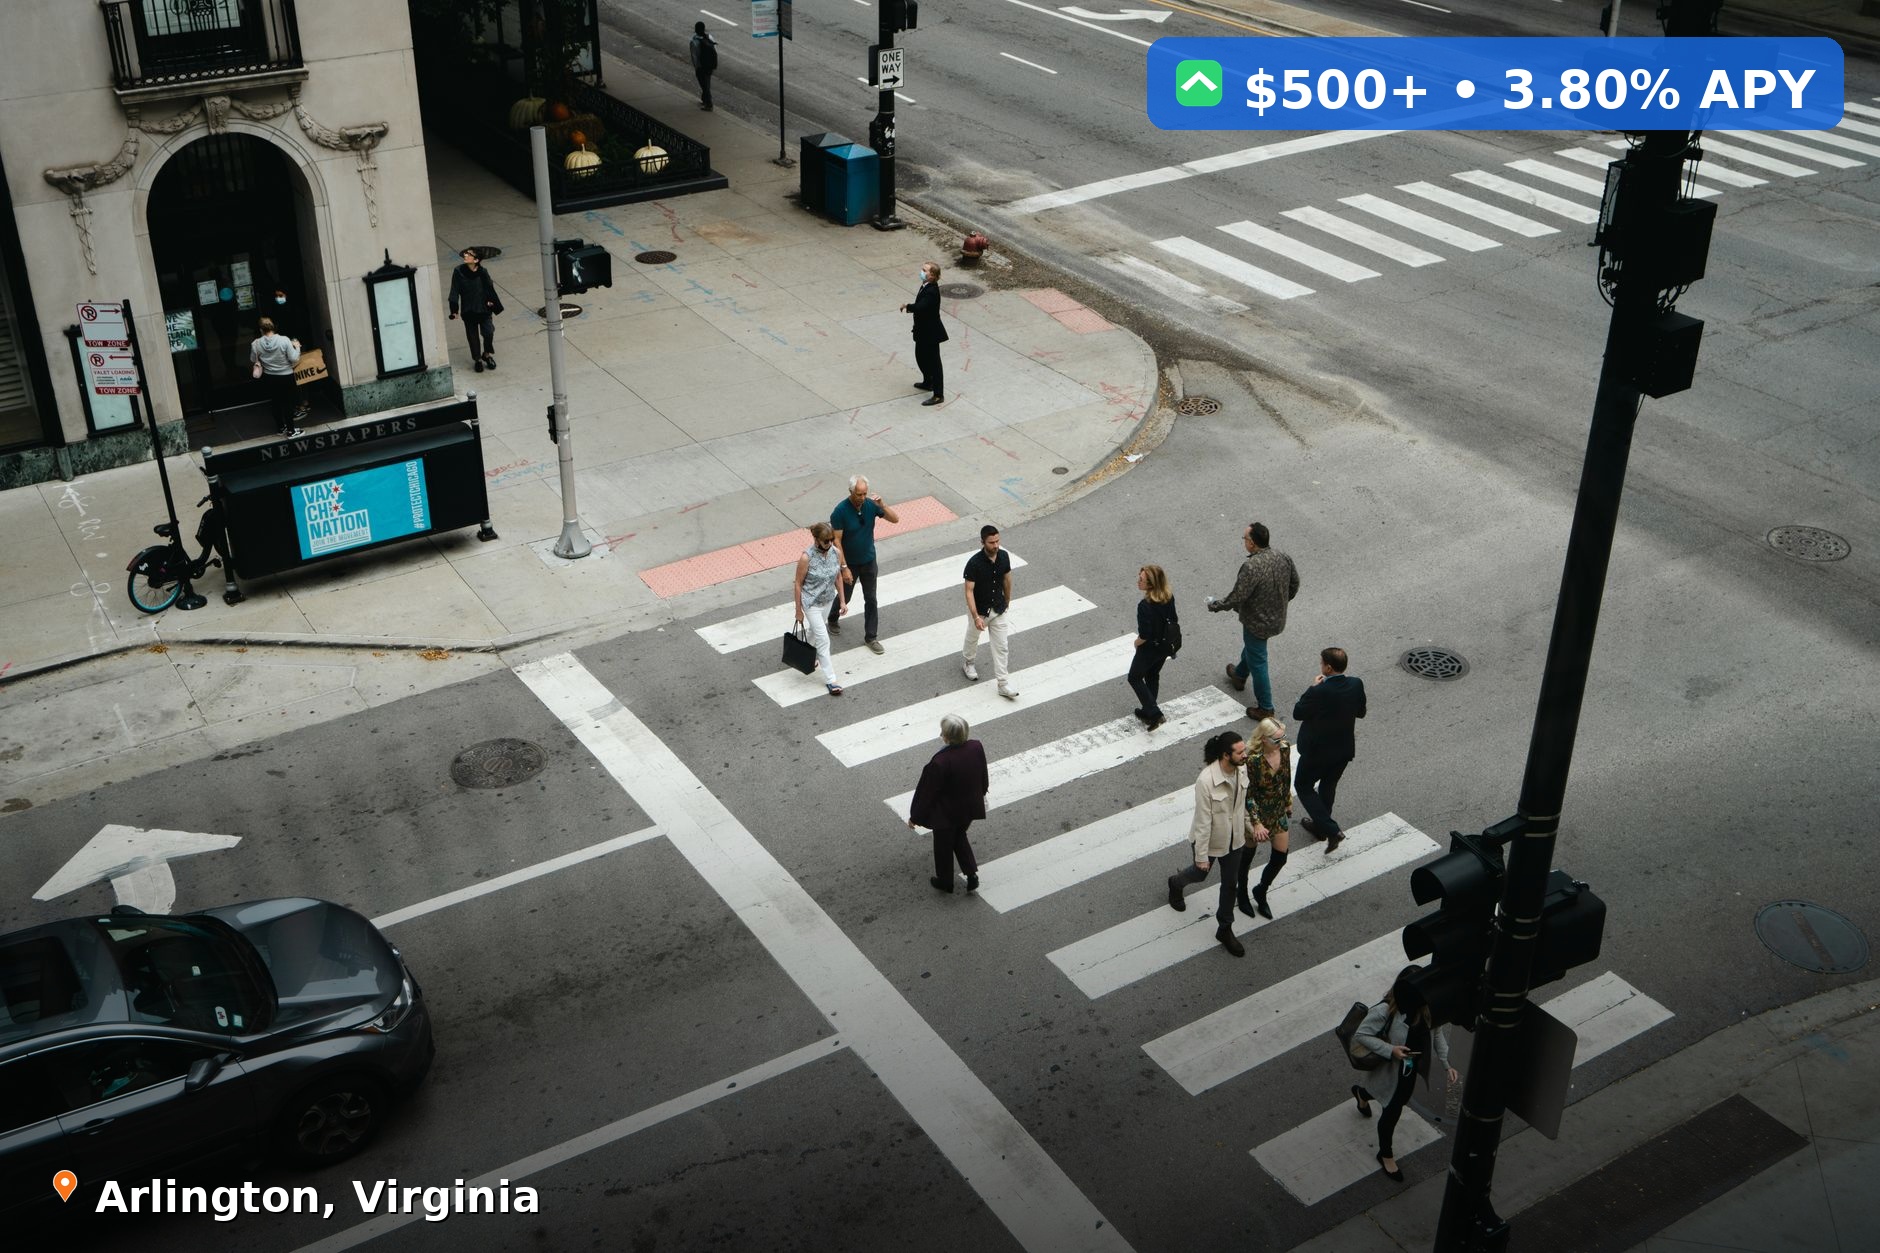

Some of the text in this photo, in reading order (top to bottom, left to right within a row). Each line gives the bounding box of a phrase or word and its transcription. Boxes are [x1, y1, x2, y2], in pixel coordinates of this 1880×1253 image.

[881, 51, 901, 63] ONE
[881, 62, 901, 74] WAY
[294, 367, 315, 381] NIKE
[261, 417, 417, 461] NEWSPAPERS
[303, 482, 335, 504] VAX
[405, 460, 425, 529] #PROTECTCHICAGO
[309, 511, 368, 540] NATION
[327, 535, 338, 544] THE
